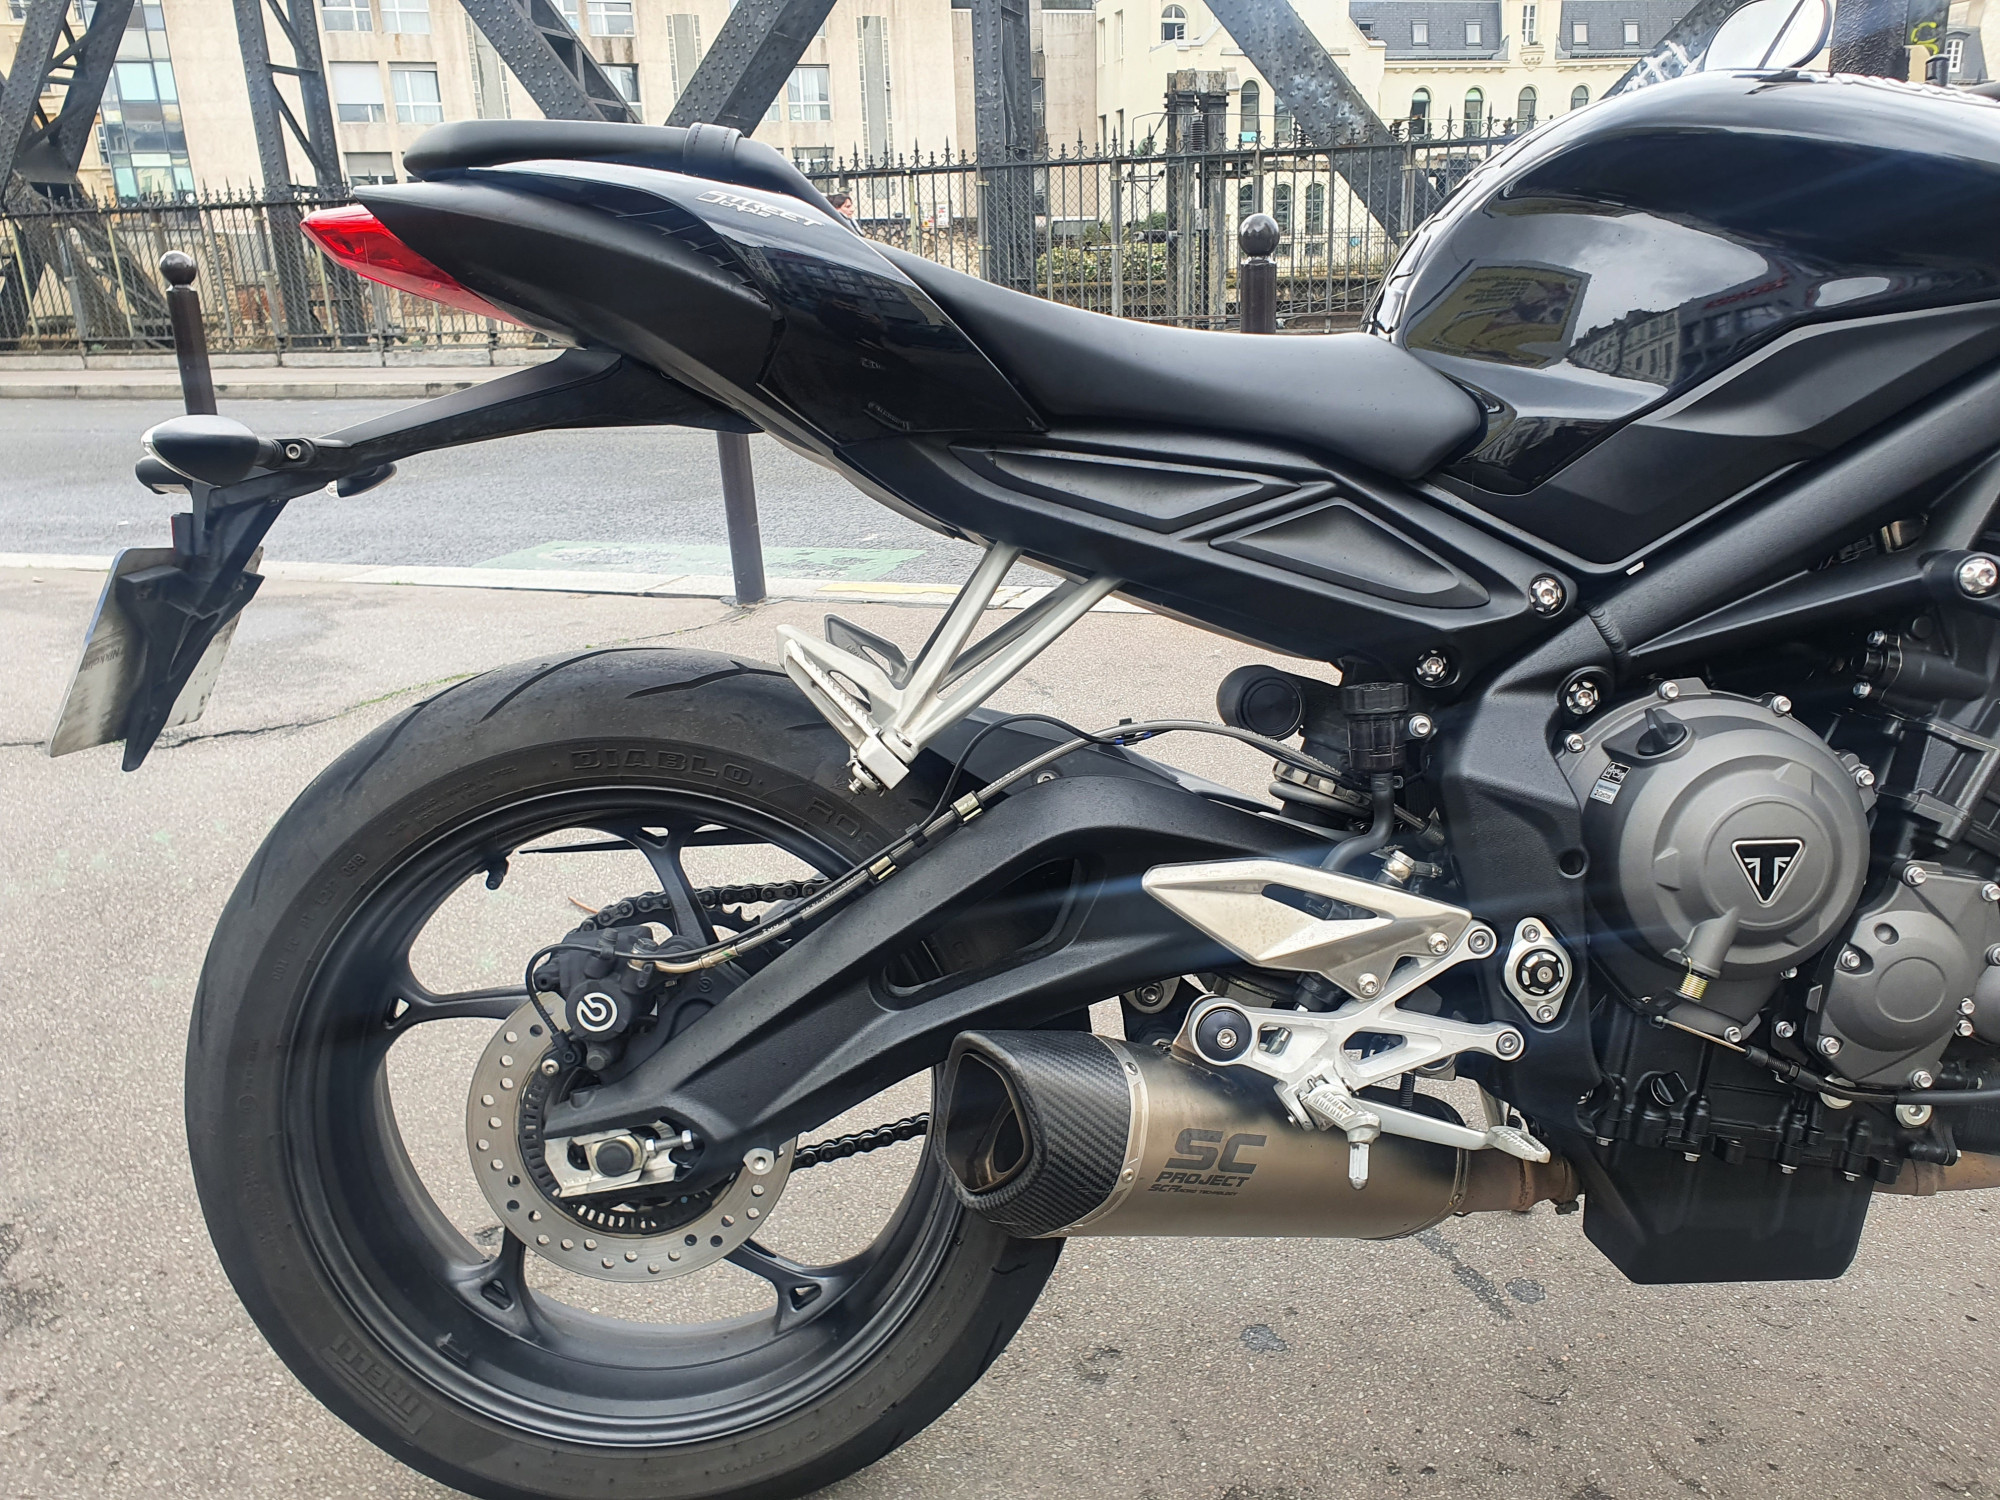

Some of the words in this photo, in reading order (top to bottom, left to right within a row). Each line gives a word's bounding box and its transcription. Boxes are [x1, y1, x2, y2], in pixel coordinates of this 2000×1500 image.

[571, 748, 751, 785] DIABLO
[1165, 1128, 1267, 1174] SC
[1155, 1171, 1250, 1187] PROJECT
